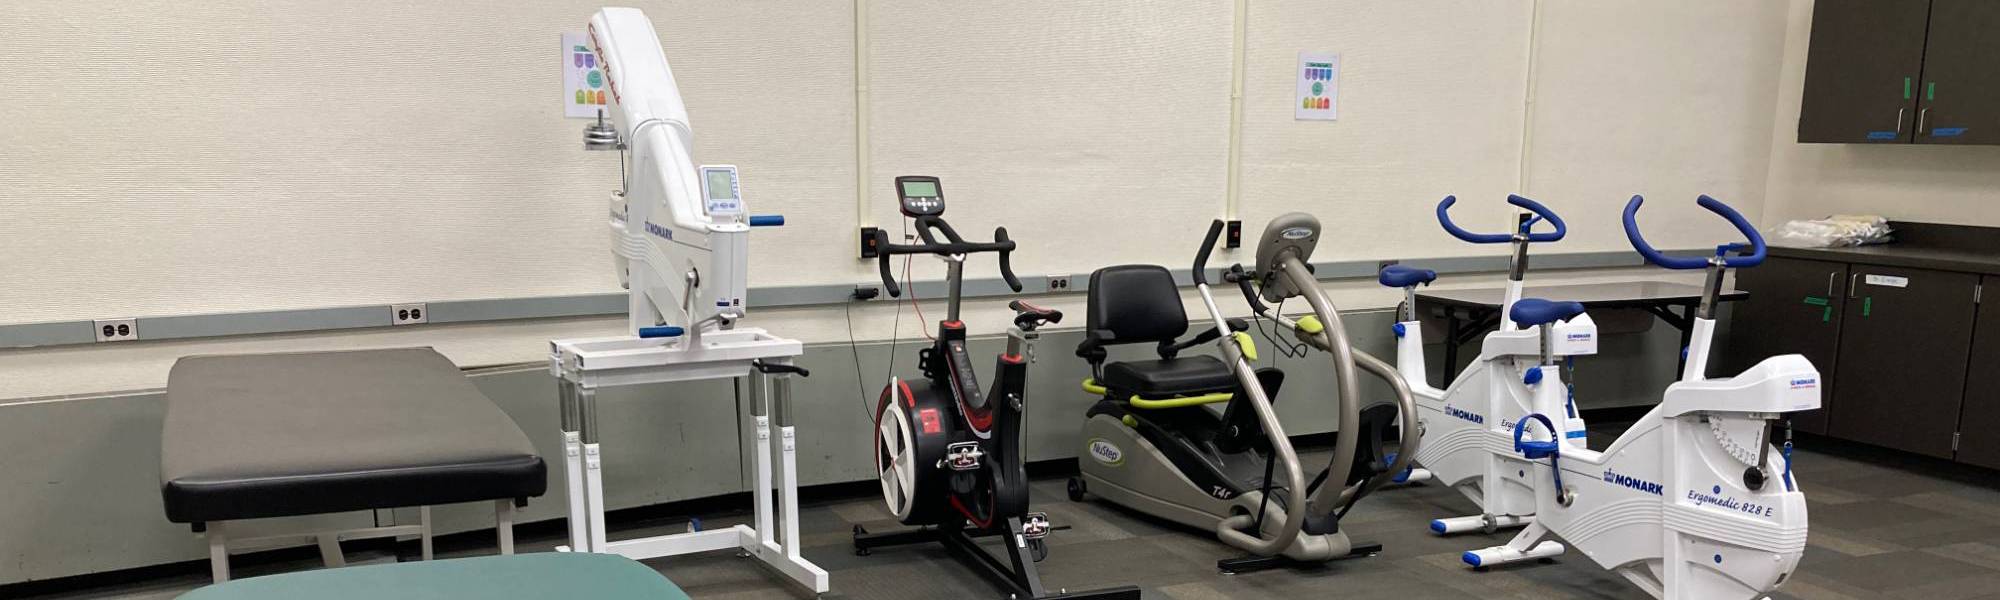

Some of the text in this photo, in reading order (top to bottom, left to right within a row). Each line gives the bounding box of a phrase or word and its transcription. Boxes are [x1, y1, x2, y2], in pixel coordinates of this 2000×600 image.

[1453, 409, 1484, 424] MONARK
[1093, 442, 1118, 460] NuStep
[1615, 474, 1664, 496] MONARK
[1687, 489, 1773, 517] Ergomedic 828 E
